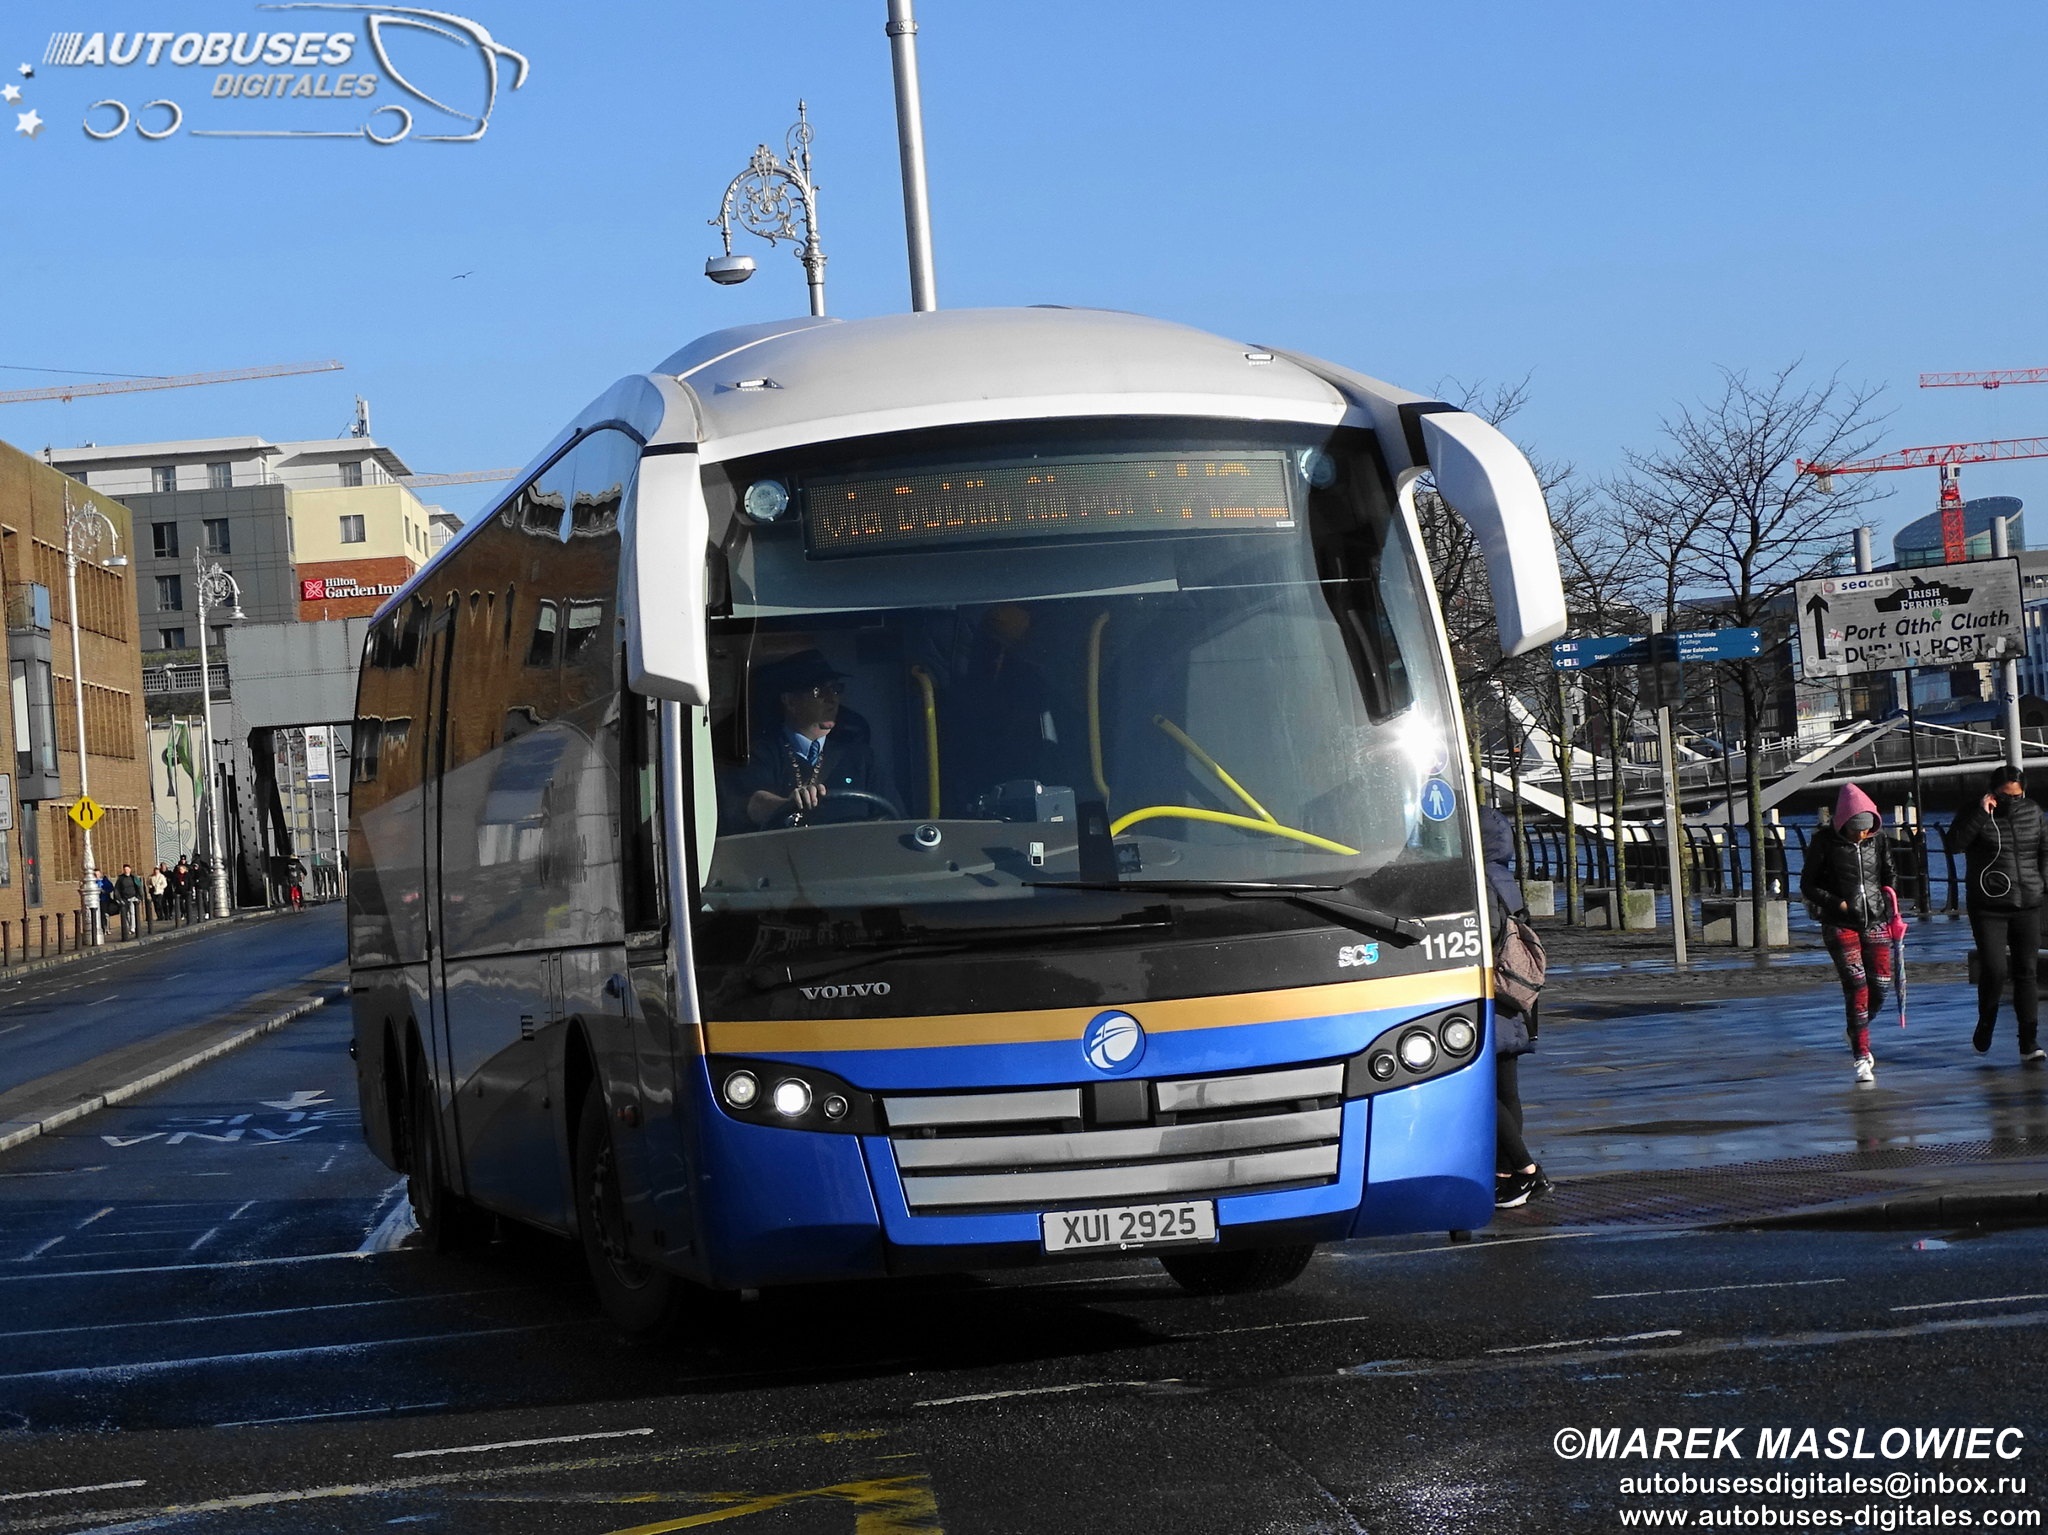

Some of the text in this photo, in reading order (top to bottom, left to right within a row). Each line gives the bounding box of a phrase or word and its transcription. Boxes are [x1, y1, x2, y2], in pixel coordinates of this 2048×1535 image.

[325, 578, 357, 587] Hilton
[1841, 575, 1891, 592] seacat
[325, 585, 376, 598] Garden
[1908, 587, 1941, 600] IRISH
[1900, 597, 1949, 611] FERRIES
[1844, 621, 1887, 642] Port
[1951, 608, 2010, 631] Cliath
[1419, 930, 1481, 960] 1125
[800, 982, 891, 1000] VOLVO
[1062, 1207, 1197, 1245] XUI 2925
